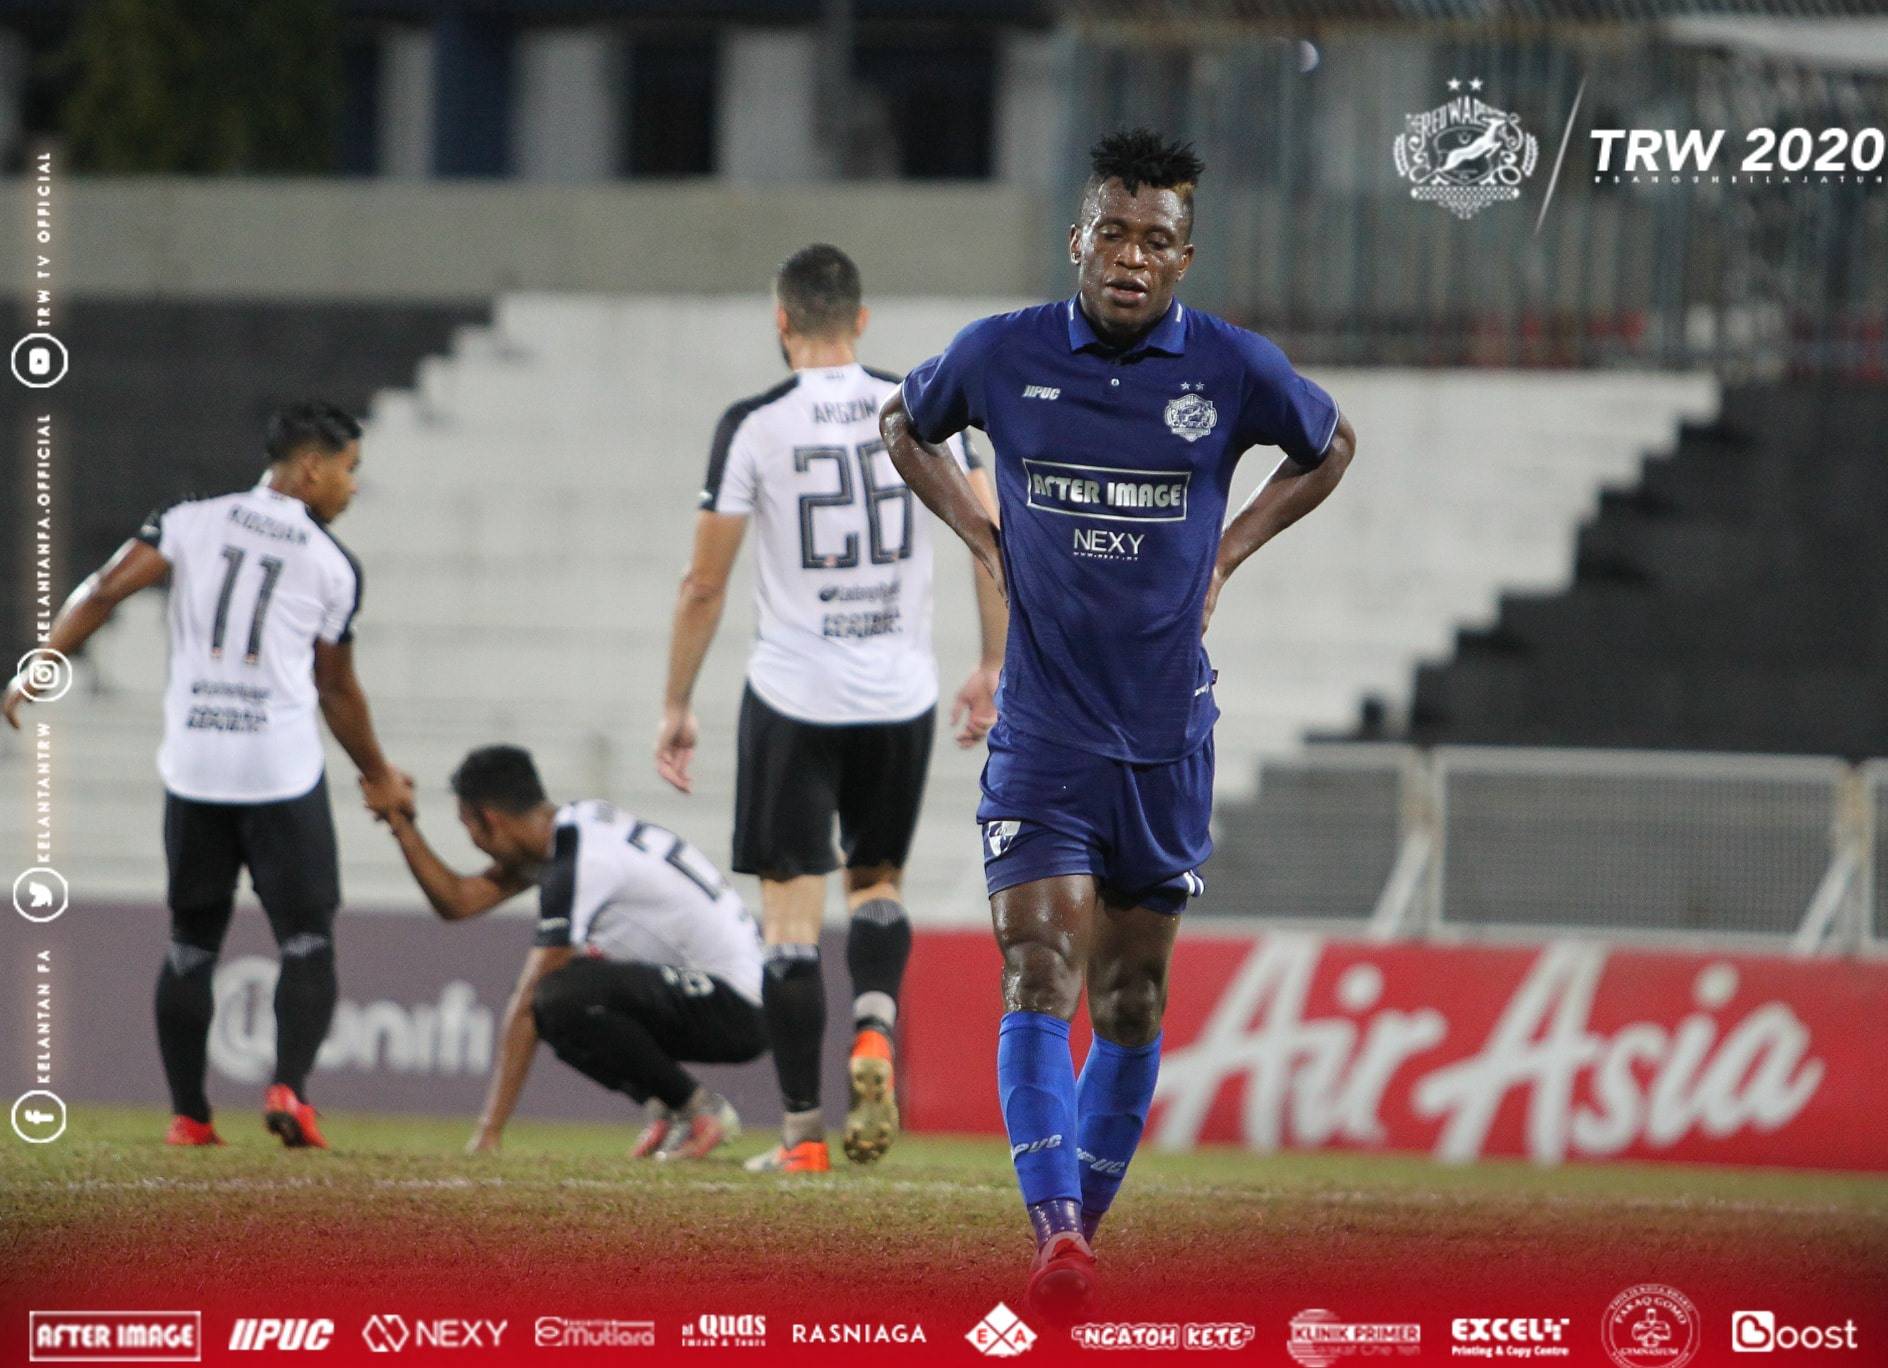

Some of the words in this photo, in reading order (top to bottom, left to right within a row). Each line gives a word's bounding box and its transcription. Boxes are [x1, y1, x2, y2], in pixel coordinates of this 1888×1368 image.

[793, 438, 914, 569] 26
[1033, 473, 1100, 505] AFTER
[1106, 480, 1182, 508] IMAGE
[1073, 528, 1145, 555] NEXY
[210, 545, 284, 666] 11
[1155, 931, 1448, 1152] Air
[1413, 938, 1824, 1166] Asia
